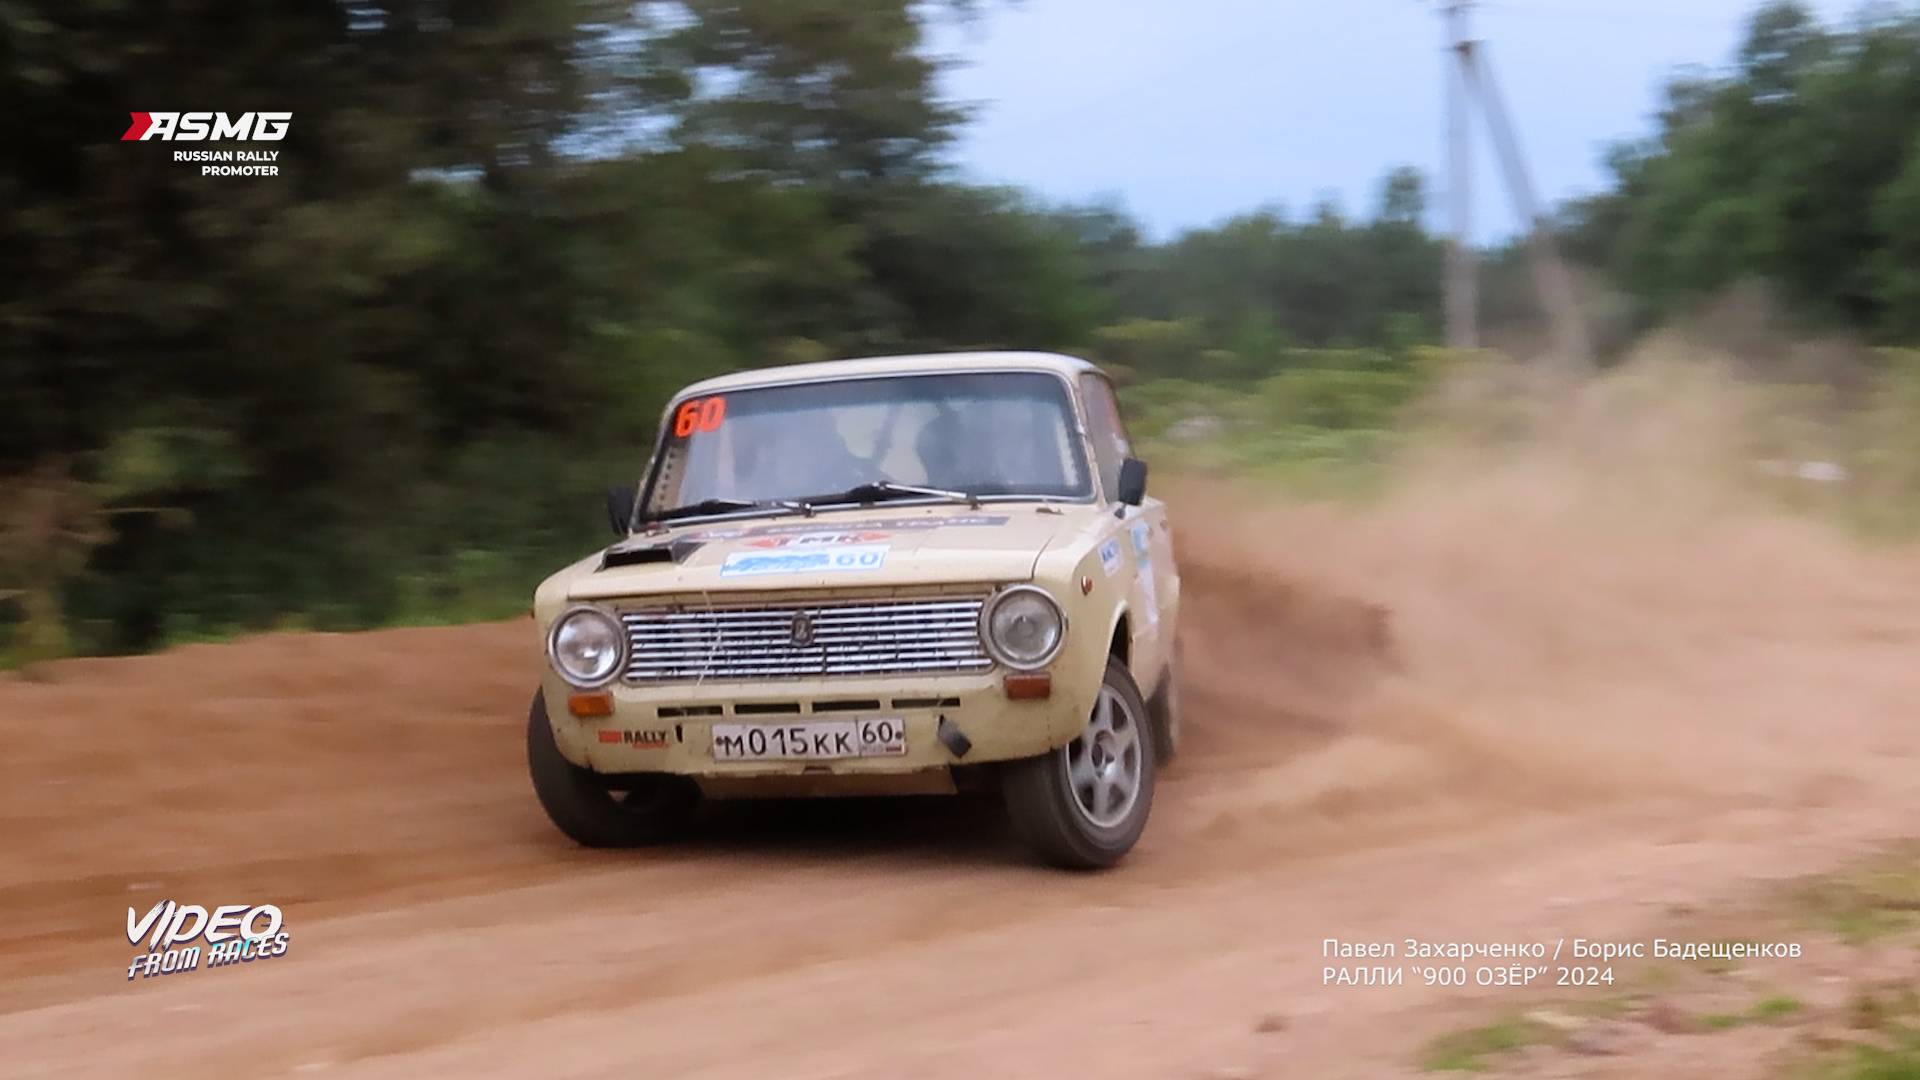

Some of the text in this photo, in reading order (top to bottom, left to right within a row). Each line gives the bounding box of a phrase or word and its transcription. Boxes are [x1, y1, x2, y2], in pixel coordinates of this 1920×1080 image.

[675, 396, 727, 438] 60
[834, 551, 880, 567] 60
[624, 730, 667, 745] RALLY
[862, 721, 893, 744] 60
